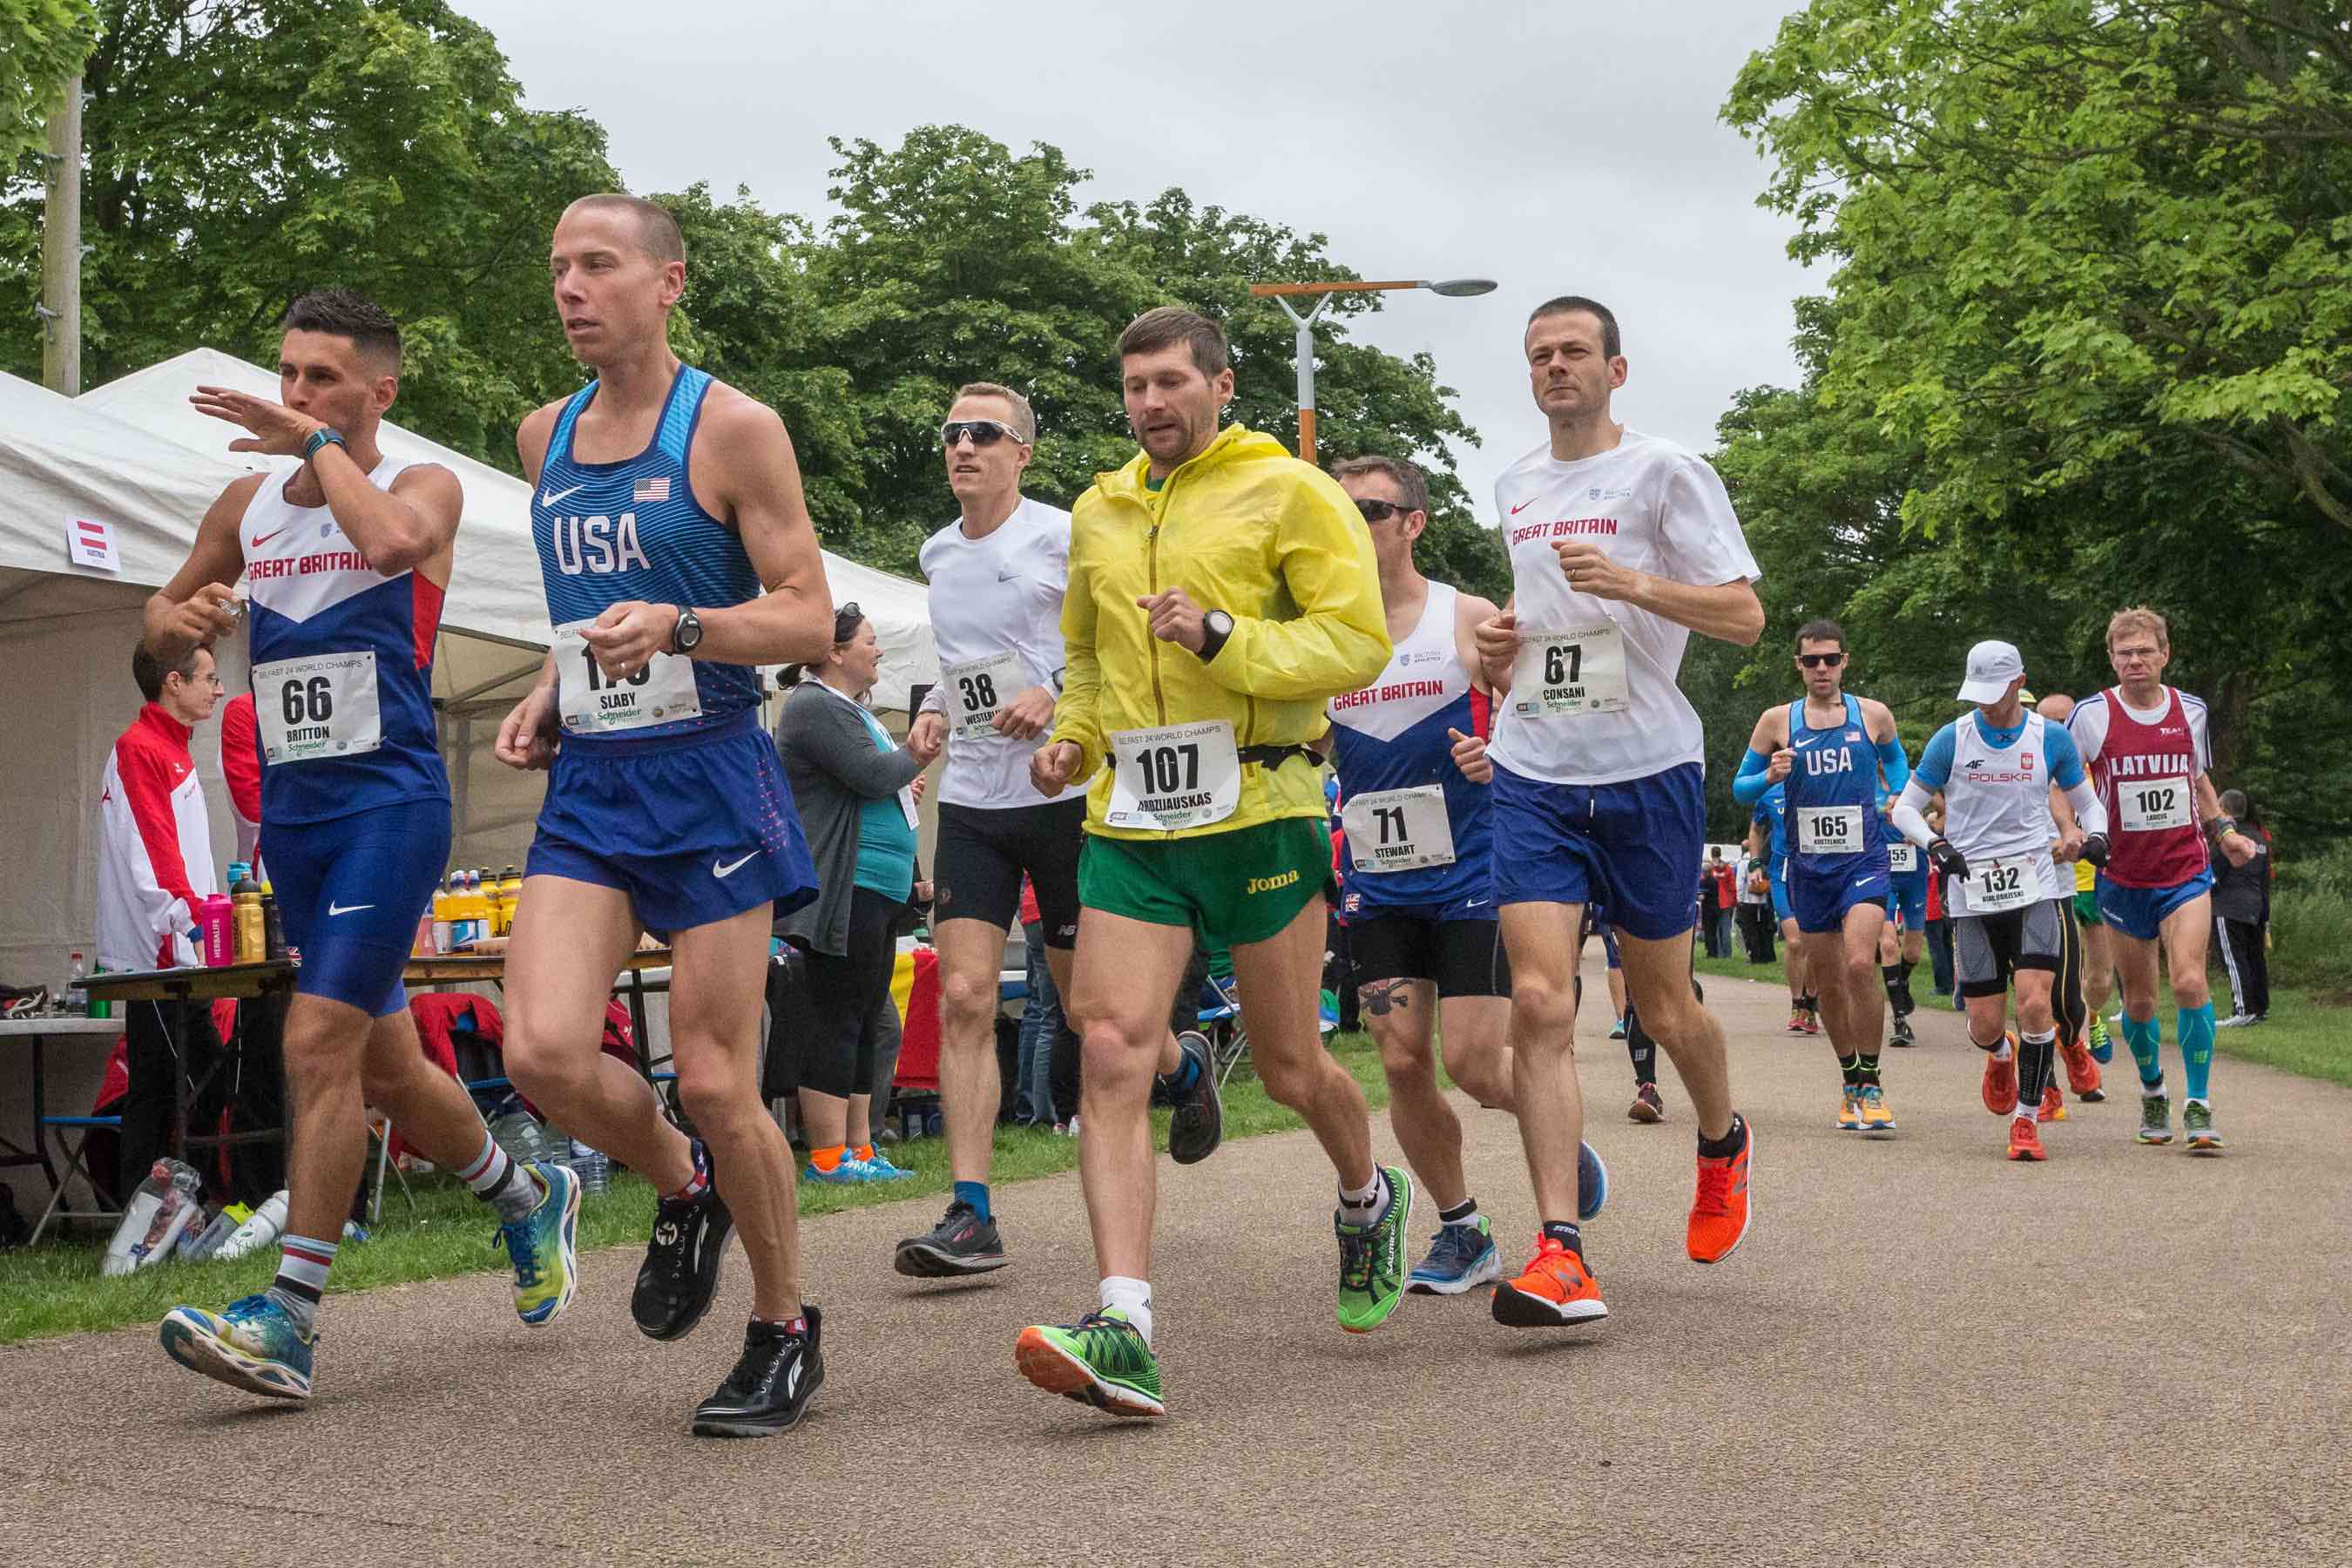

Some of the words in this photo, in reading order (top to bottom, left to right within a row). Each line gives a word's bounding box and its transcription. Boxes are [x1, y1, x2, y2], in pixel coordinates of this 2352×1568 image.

[1513, 522, 1551, 545] GREAT
[1553, 518, 1618, 537] BRITAIN
[553, 512, 652, 575] USA
[247, 557, 295, 580] GREAT
[1551, 632, 1577, 642] WORLD
[295, 663, 324, 673] WORLD
[325, 659, 363, 670] CHAMPS
[1544, 645, 1582, 686] 67
[281, 676, 333, 726] 66
[600, 692, 636, 710] SLABY
[959, 673, 997, 712] 38
[1334, 687, 1378, 711] GREAT
[1381, 679, 1443, 702] BRITAIN
[1543, 686, 1585, 700] CONSANI
[598, 708, 642, 725] Schneider
[287, 726, 330, 742] BRITTON
[1153, 731, 1183, 741] WORLD
[1184, 725, 1222, 739] CHAMPS
[1136, 743, 1199, 795] 107
[1806, 747, 1854, 776] USA
[2111, 754, 2189, 776] LATVIJA
[1968, 773, 2033, 782] POLSKA
[2136, 788, 2175, 814] 102
[1152, 810, 1193, 827] Schneider
[1372, 806, 1409, 844] 71
[1811, 815, 1848, 837] 165
[1374, 844, 1415, 859] STEWART
[1247, 869, 1298, 895] Joma
[1980, 867, 2020, 894] 132
